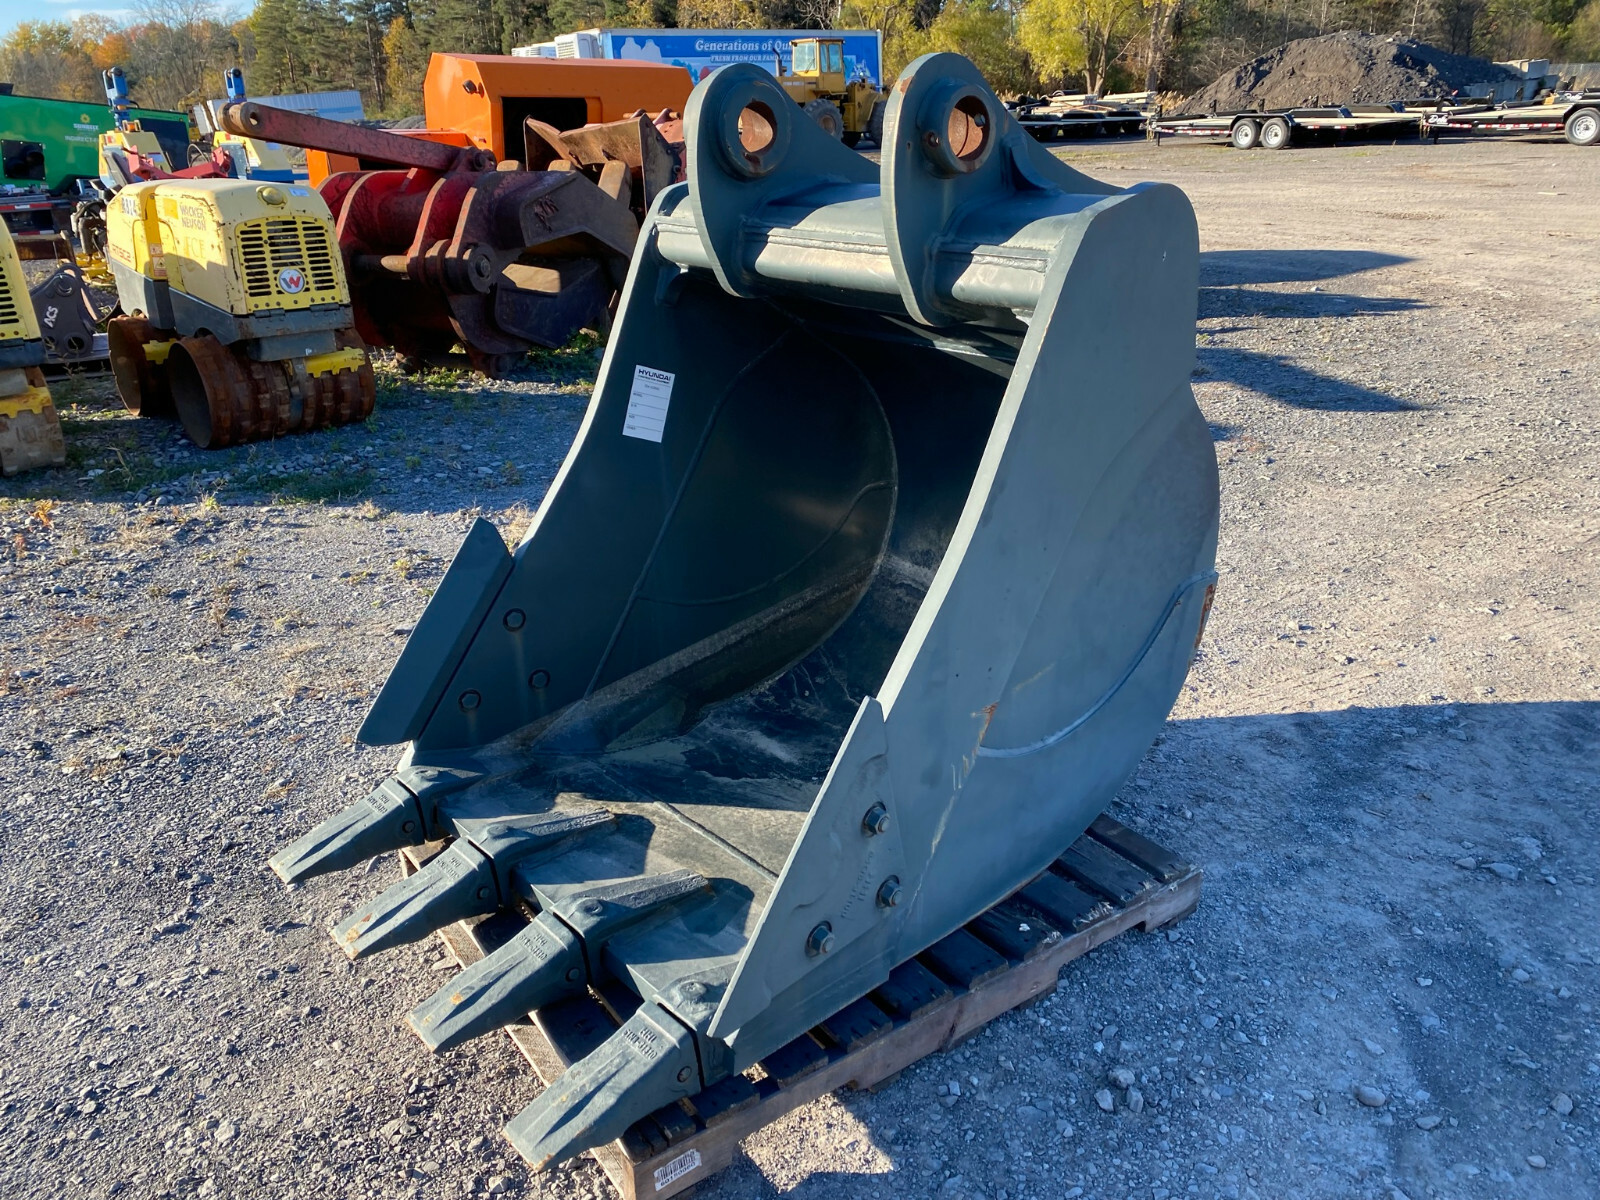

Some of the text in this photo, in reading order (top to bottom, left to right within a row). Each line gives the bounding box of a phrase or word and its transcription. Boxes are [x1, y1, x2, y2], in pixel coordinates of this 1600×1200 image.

[695, 39, 759, 51] Generations
[762, 40, 772, 51] of
[180, 204, 205, 218] WACKER
[182, 217, 207, 231] NEUSON
[44, 305, 58, 328] ACS
[638, 368, 671, 382] HYUNDAI
